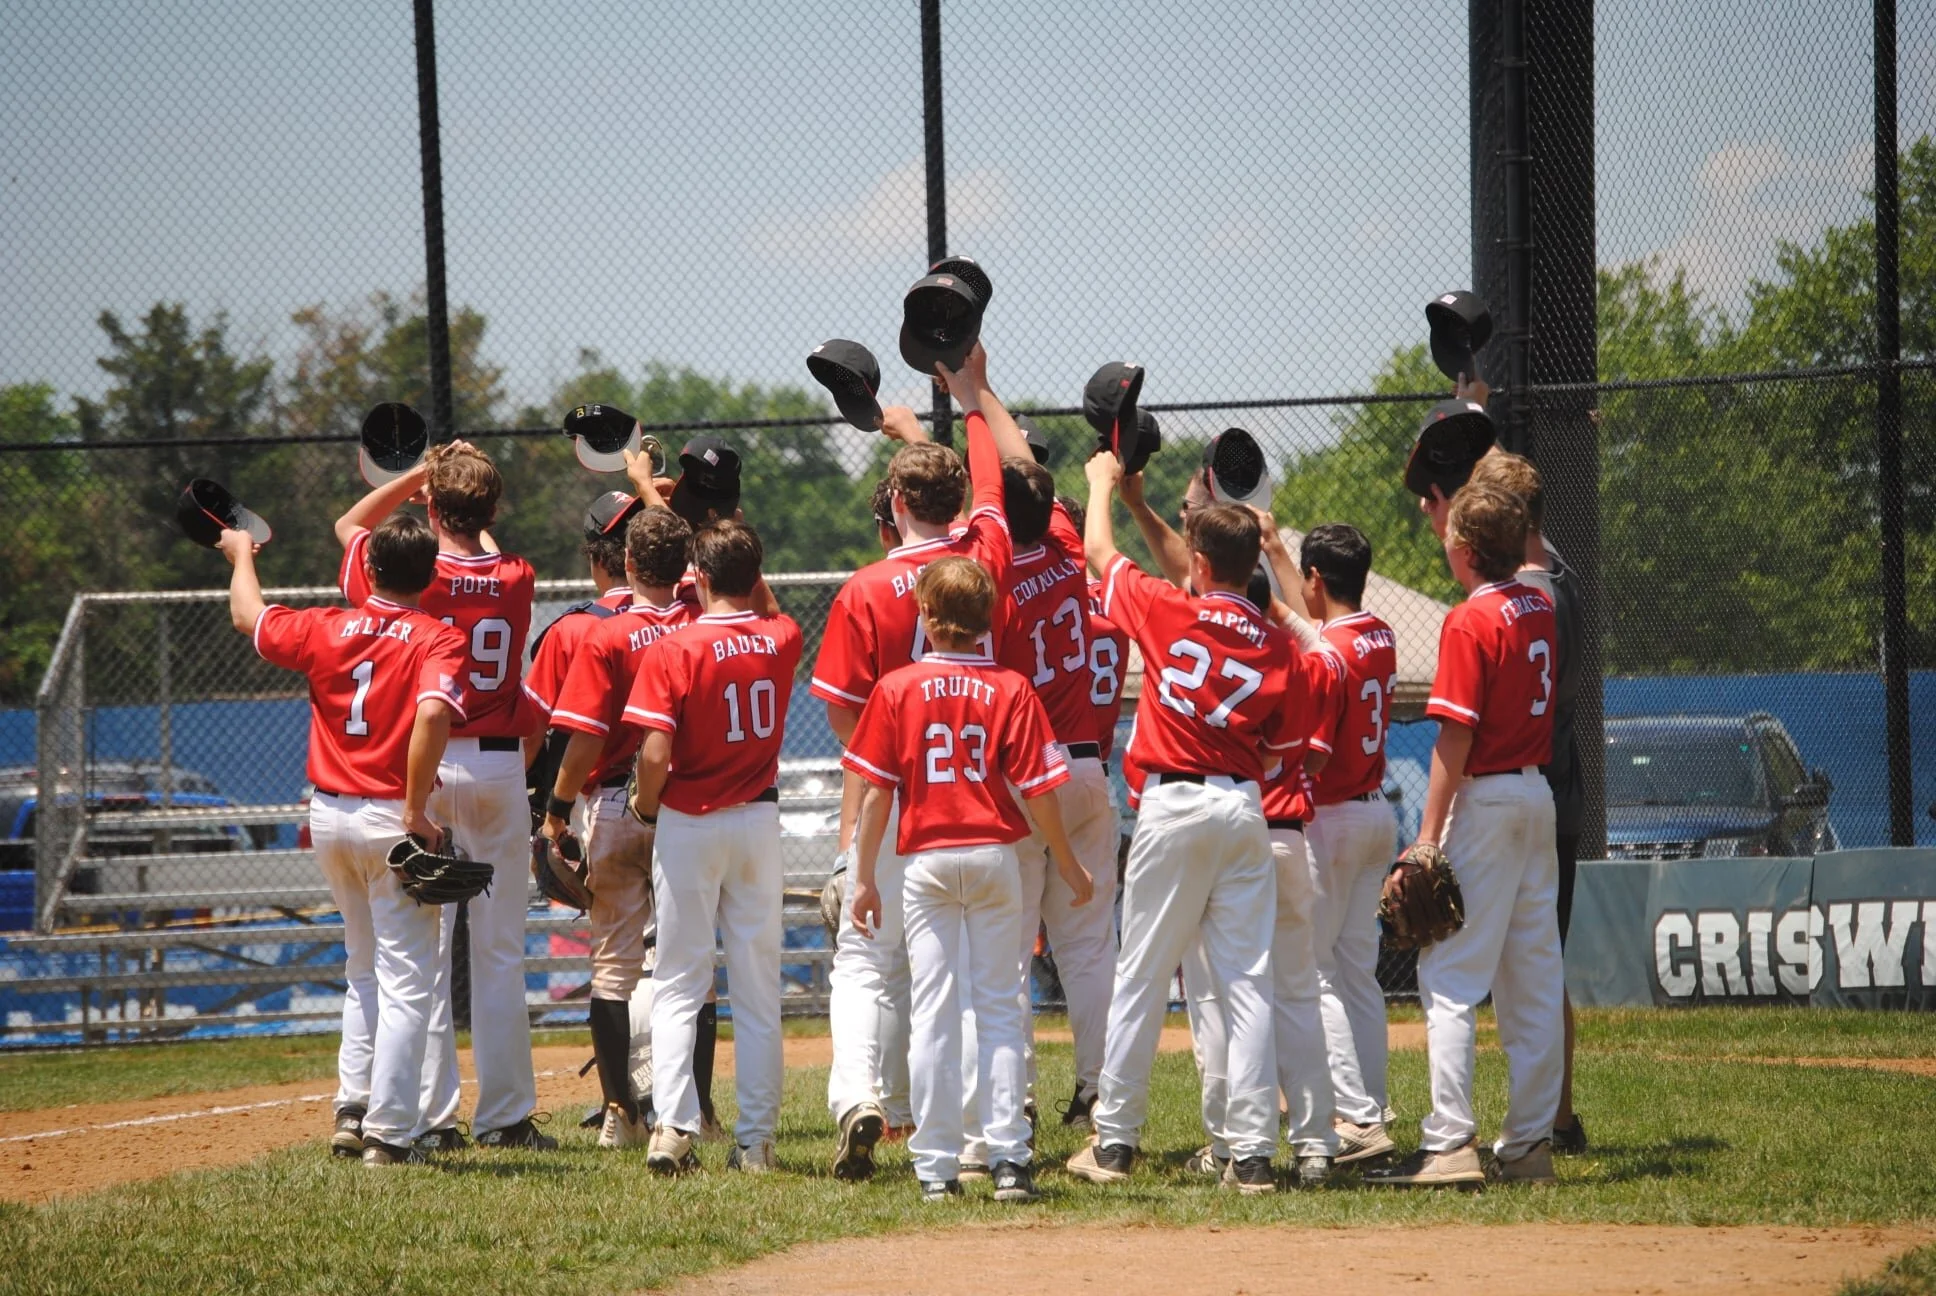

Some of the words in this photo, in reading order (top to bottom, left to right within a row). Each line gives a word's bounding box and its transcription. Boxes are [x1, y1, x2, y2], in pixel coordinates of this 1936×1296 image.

[450, 575, 500, 598] POPE
[340, 616, 413, 644] MILLER
[440, 616, 513, 692] 9
[712, 634, 778, 663] BAUER
[1028, 596, 1086, 688] 13
[1198, 609, 1267, 649] CAPONI
[344, 660, 376, 737] 1
[920, 676, 995, 706] TRUITT
[1158, 637, 1264, 729] 27
[1528, 639, 1552, 716] 3
[723, 679, 776, 743] 10
[924, 722, 988, 784] 23
